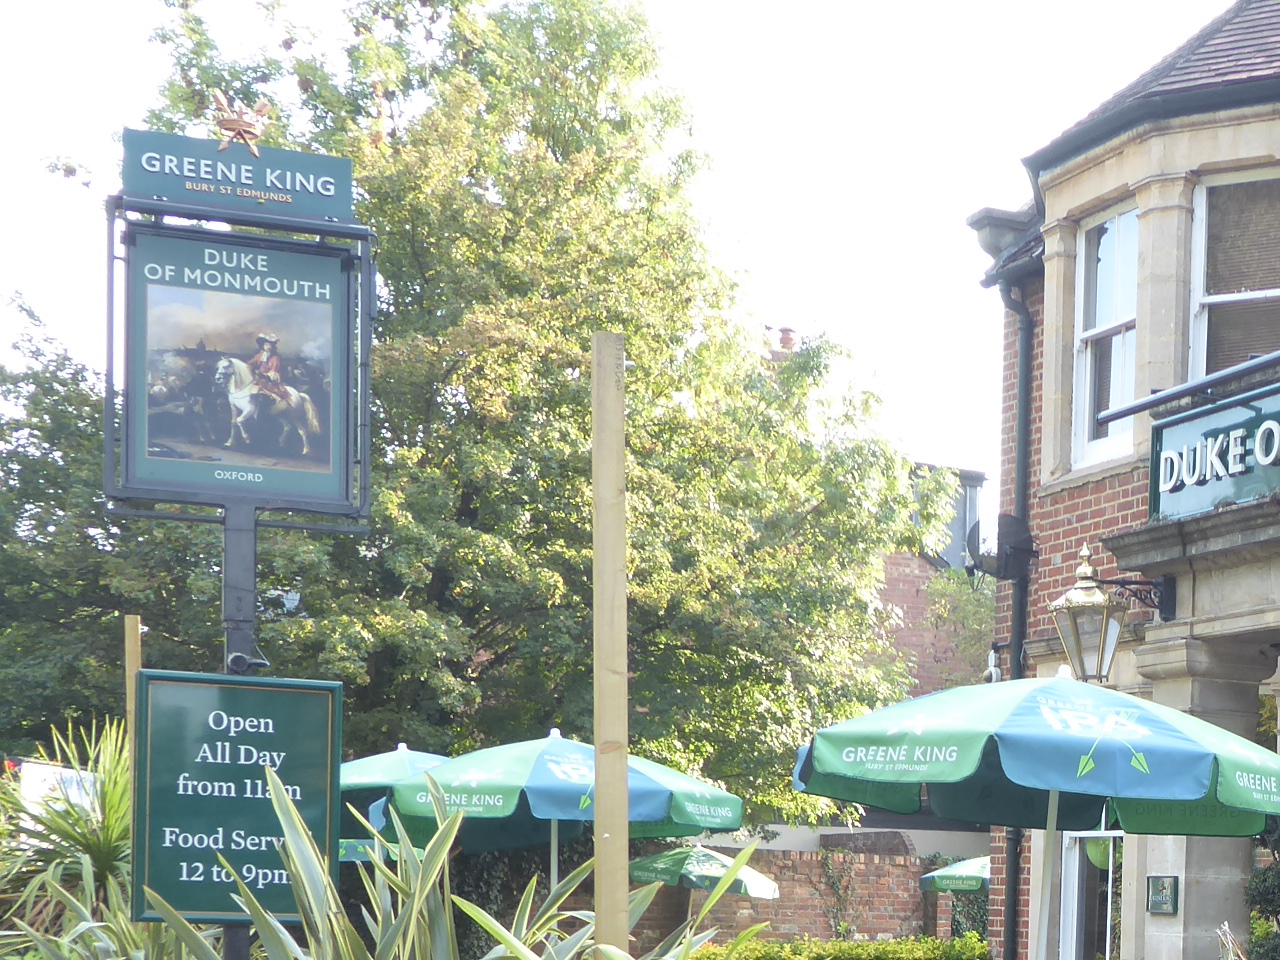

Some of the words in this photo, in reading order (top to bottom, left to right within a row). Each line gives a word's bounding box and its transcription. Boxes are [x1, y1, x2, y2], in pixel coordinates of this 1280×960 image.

[141, 151, 254, 185] GREENE
[265, 167, 336, 197] KING
[185, 181, 215, 193] BURY
[219, 185, 233, 194] ST
[236, 187, 292, 204] EDMUNDS
[204, 248, 269, 272] DUKE
[144, 263, 176, 282] OF
[184, 268, 331, 300] MONMOUTH
[1159, 428, 1247, 494] DUKE
[214, 469, 263, 483] OXFORD
[208, 711, 274, 736] Open
[195, 742, 231, 764] All
[237, 745, 286, 771] Day
[842, 745, 908, 762] GREENE
[913, 746, 958, 762] KING
[177, 773, 236, 797] from
[1236, 771, 1277, 792] GREENE
[472, 794, 503, 806] KING
[710, 806, 732, 817] KING
[162, 827, 224, 850] Food
[179, 862, 204, 882] 12
[211, 864, 235, 883] to
